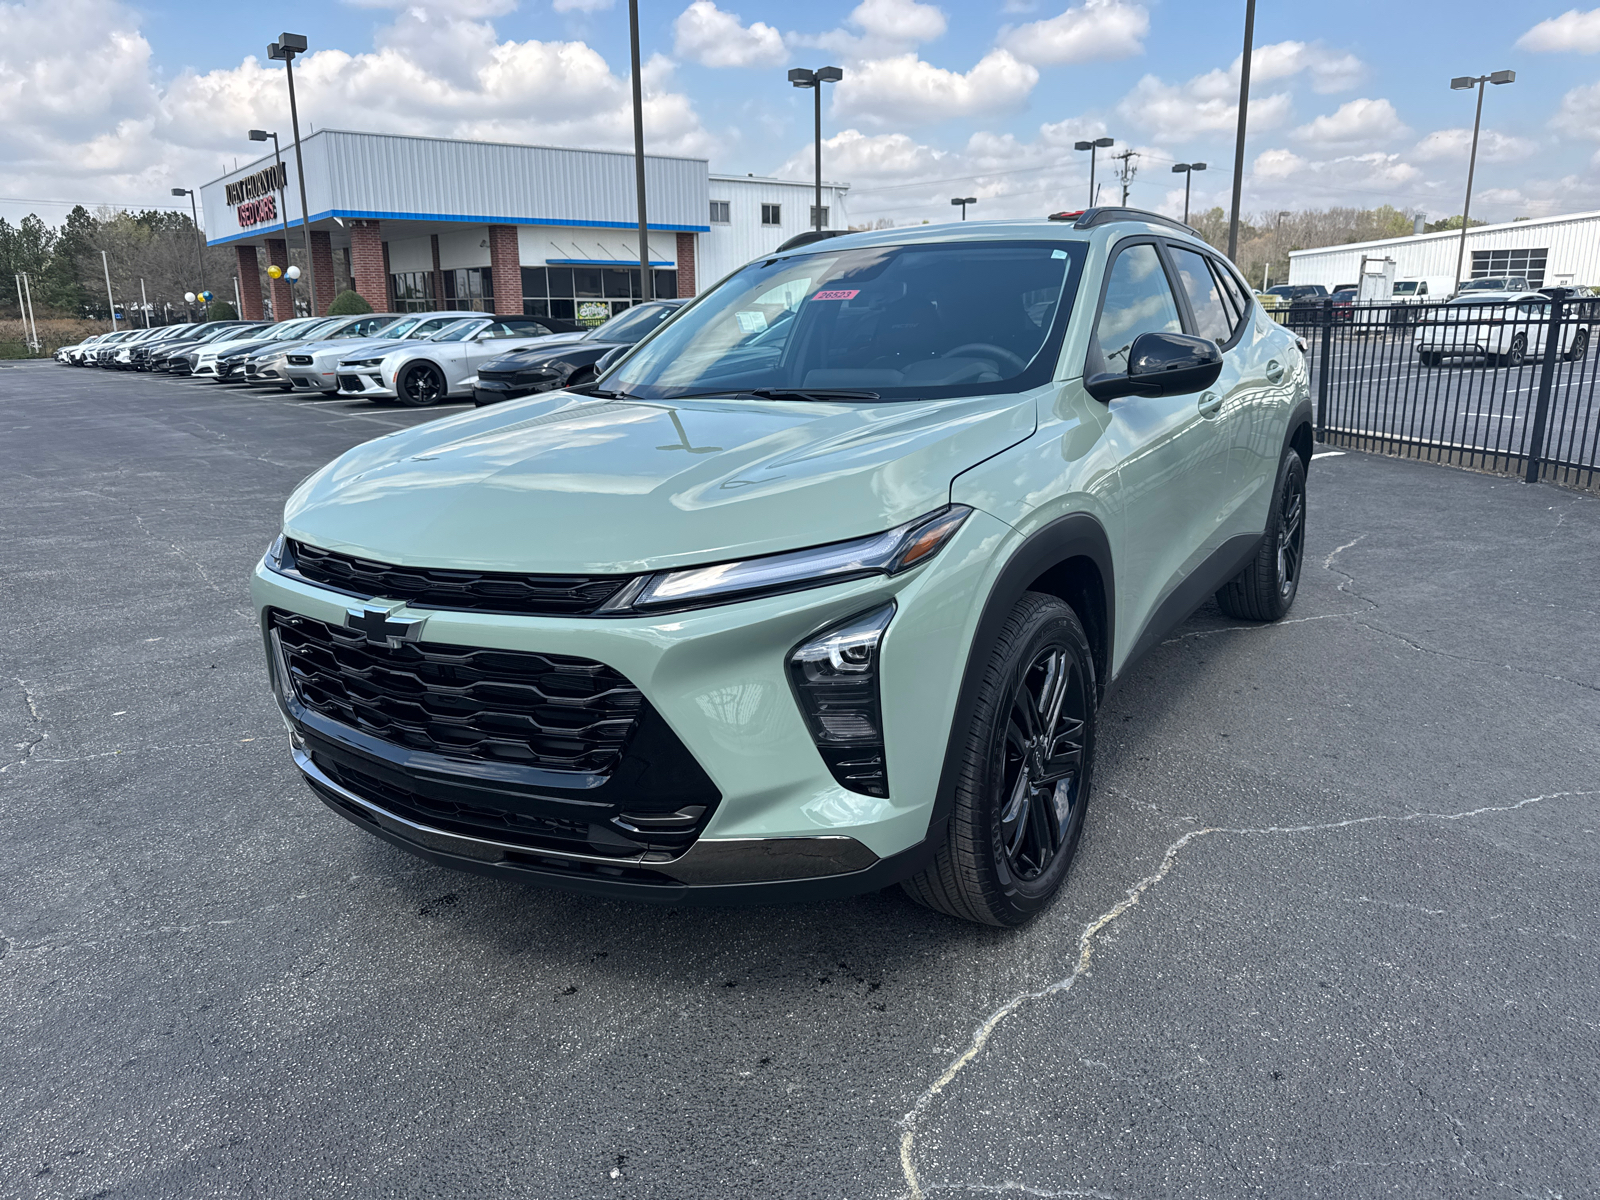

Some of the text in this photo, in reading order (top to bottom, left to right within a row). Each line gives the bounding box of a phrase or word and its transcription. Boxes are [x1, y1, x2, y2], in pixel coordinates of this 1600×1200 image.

[224, 162, 288, 206] JOHN THORNTON
[237, 195, 277, 227] USED CARS
[818, 291, 852, 299] 26523
